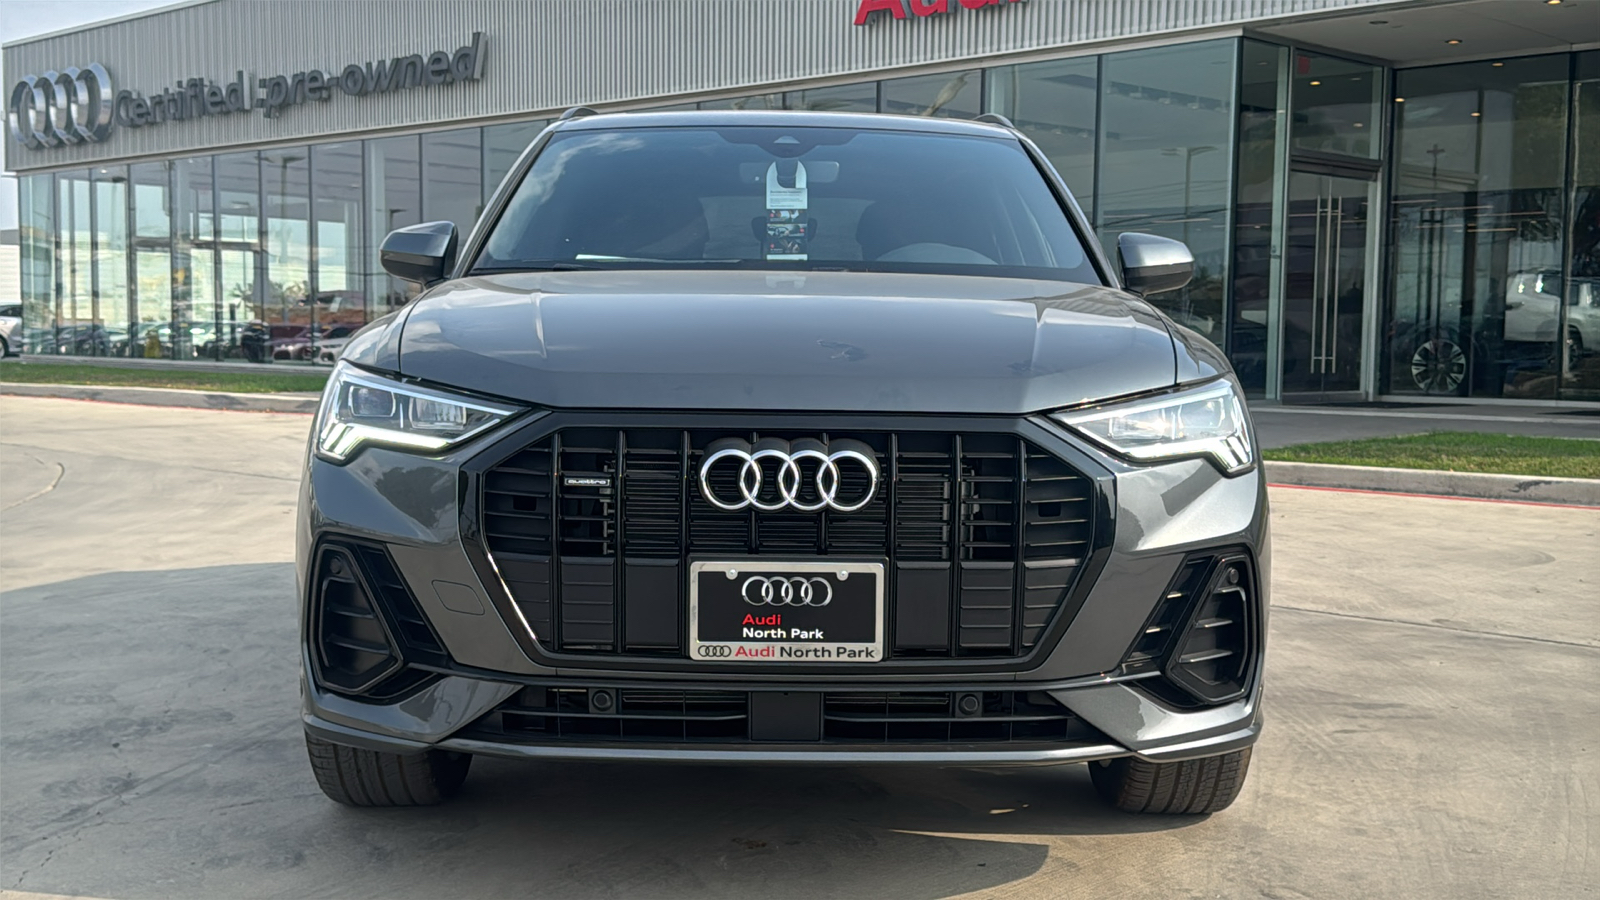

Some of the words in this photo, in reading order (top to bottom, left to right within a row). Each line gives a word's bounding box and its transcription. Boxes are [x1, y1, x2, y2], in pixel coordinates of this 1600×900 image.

[115, 70, 252, 128] Certified
[742, 613, 782, 625] Audi
[742, 627, 787, 638] North
[791, 628, 824, 639] Park
[735, 645, 775, 658] Audi
[780, 646, 832, 658] North
[836, 646, 875, 659] Park
